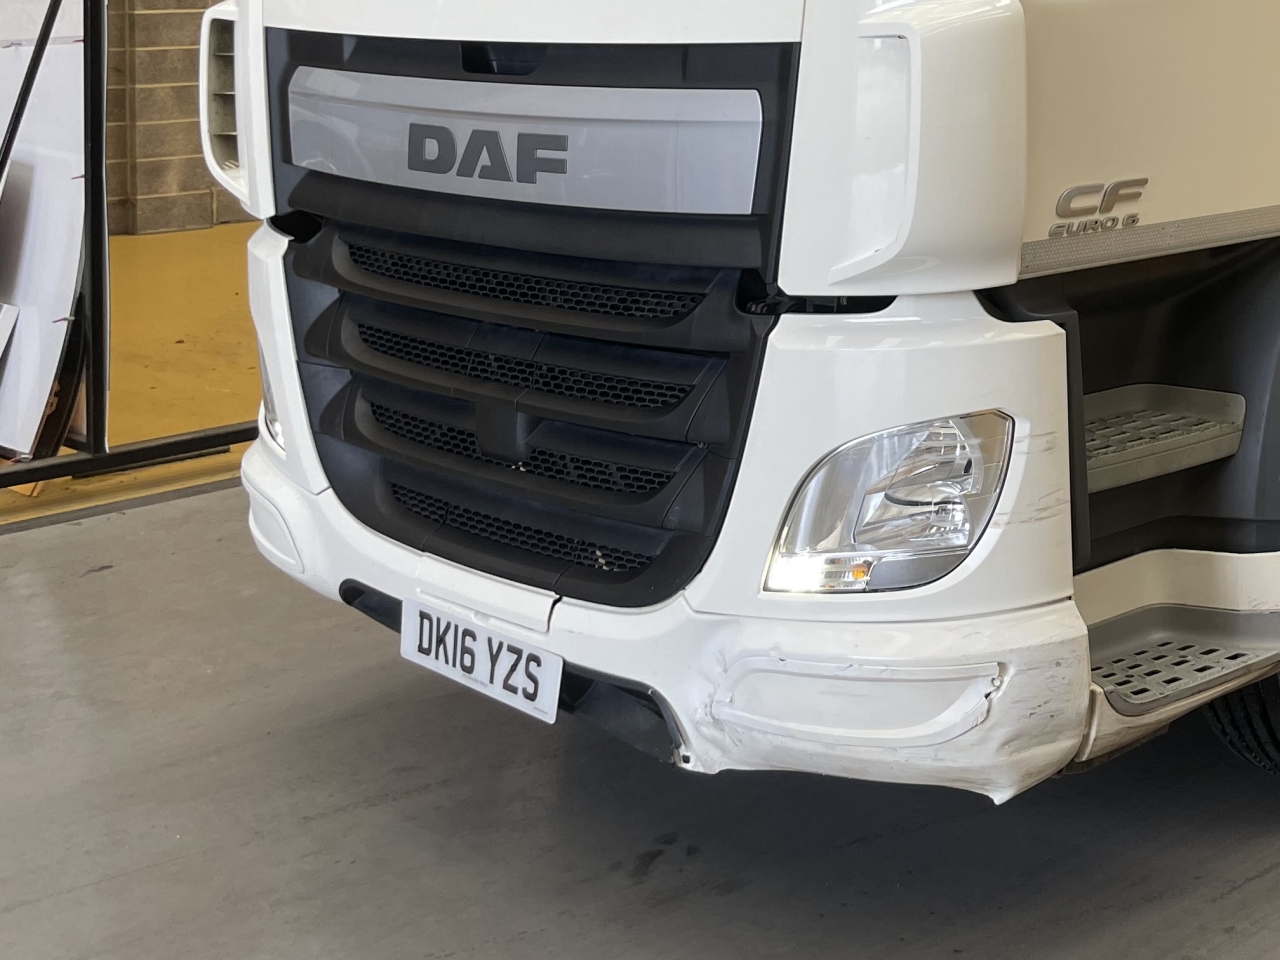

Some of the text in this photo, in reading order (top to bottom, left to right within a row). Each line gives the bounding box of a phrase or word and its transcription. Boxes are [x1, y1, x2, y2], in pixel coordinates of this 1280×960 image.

[407, 122, 569, 185] DAF
[1055, 178, 1149, 218] CF
[1048, 213, 1140, 238] EURO 6
[417, 609, 543, 703] DK16 YZS
